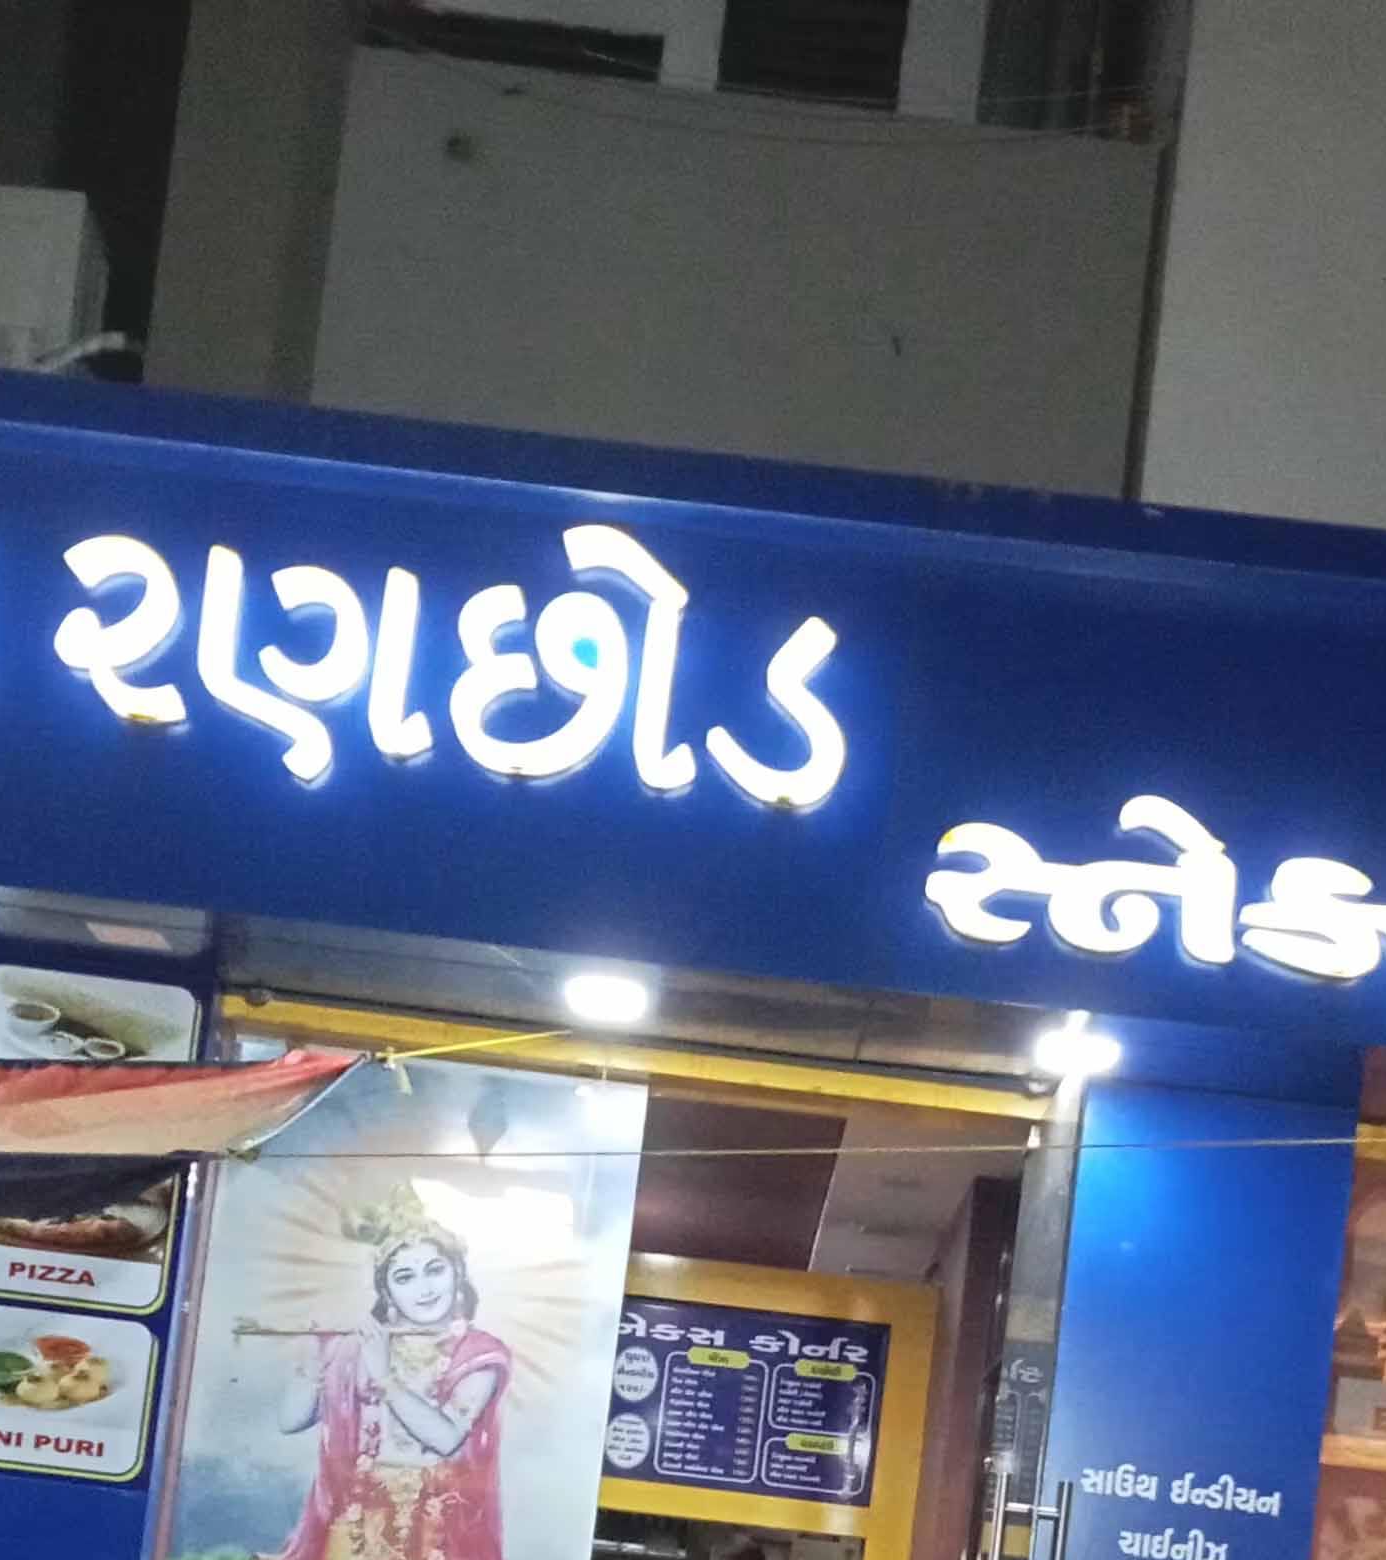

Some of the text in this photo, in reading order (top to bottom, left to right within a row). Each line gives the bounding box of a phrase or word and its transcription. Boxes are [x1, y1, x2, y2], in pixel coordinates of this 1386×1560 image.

[54, 524, 847, 808] રણછોડ
[8, 1261, 96, 1288] PIZZA
[34, 1433, 105, 1458] PURI
[1080, 1464, 1158, 1501] સાઉથ
